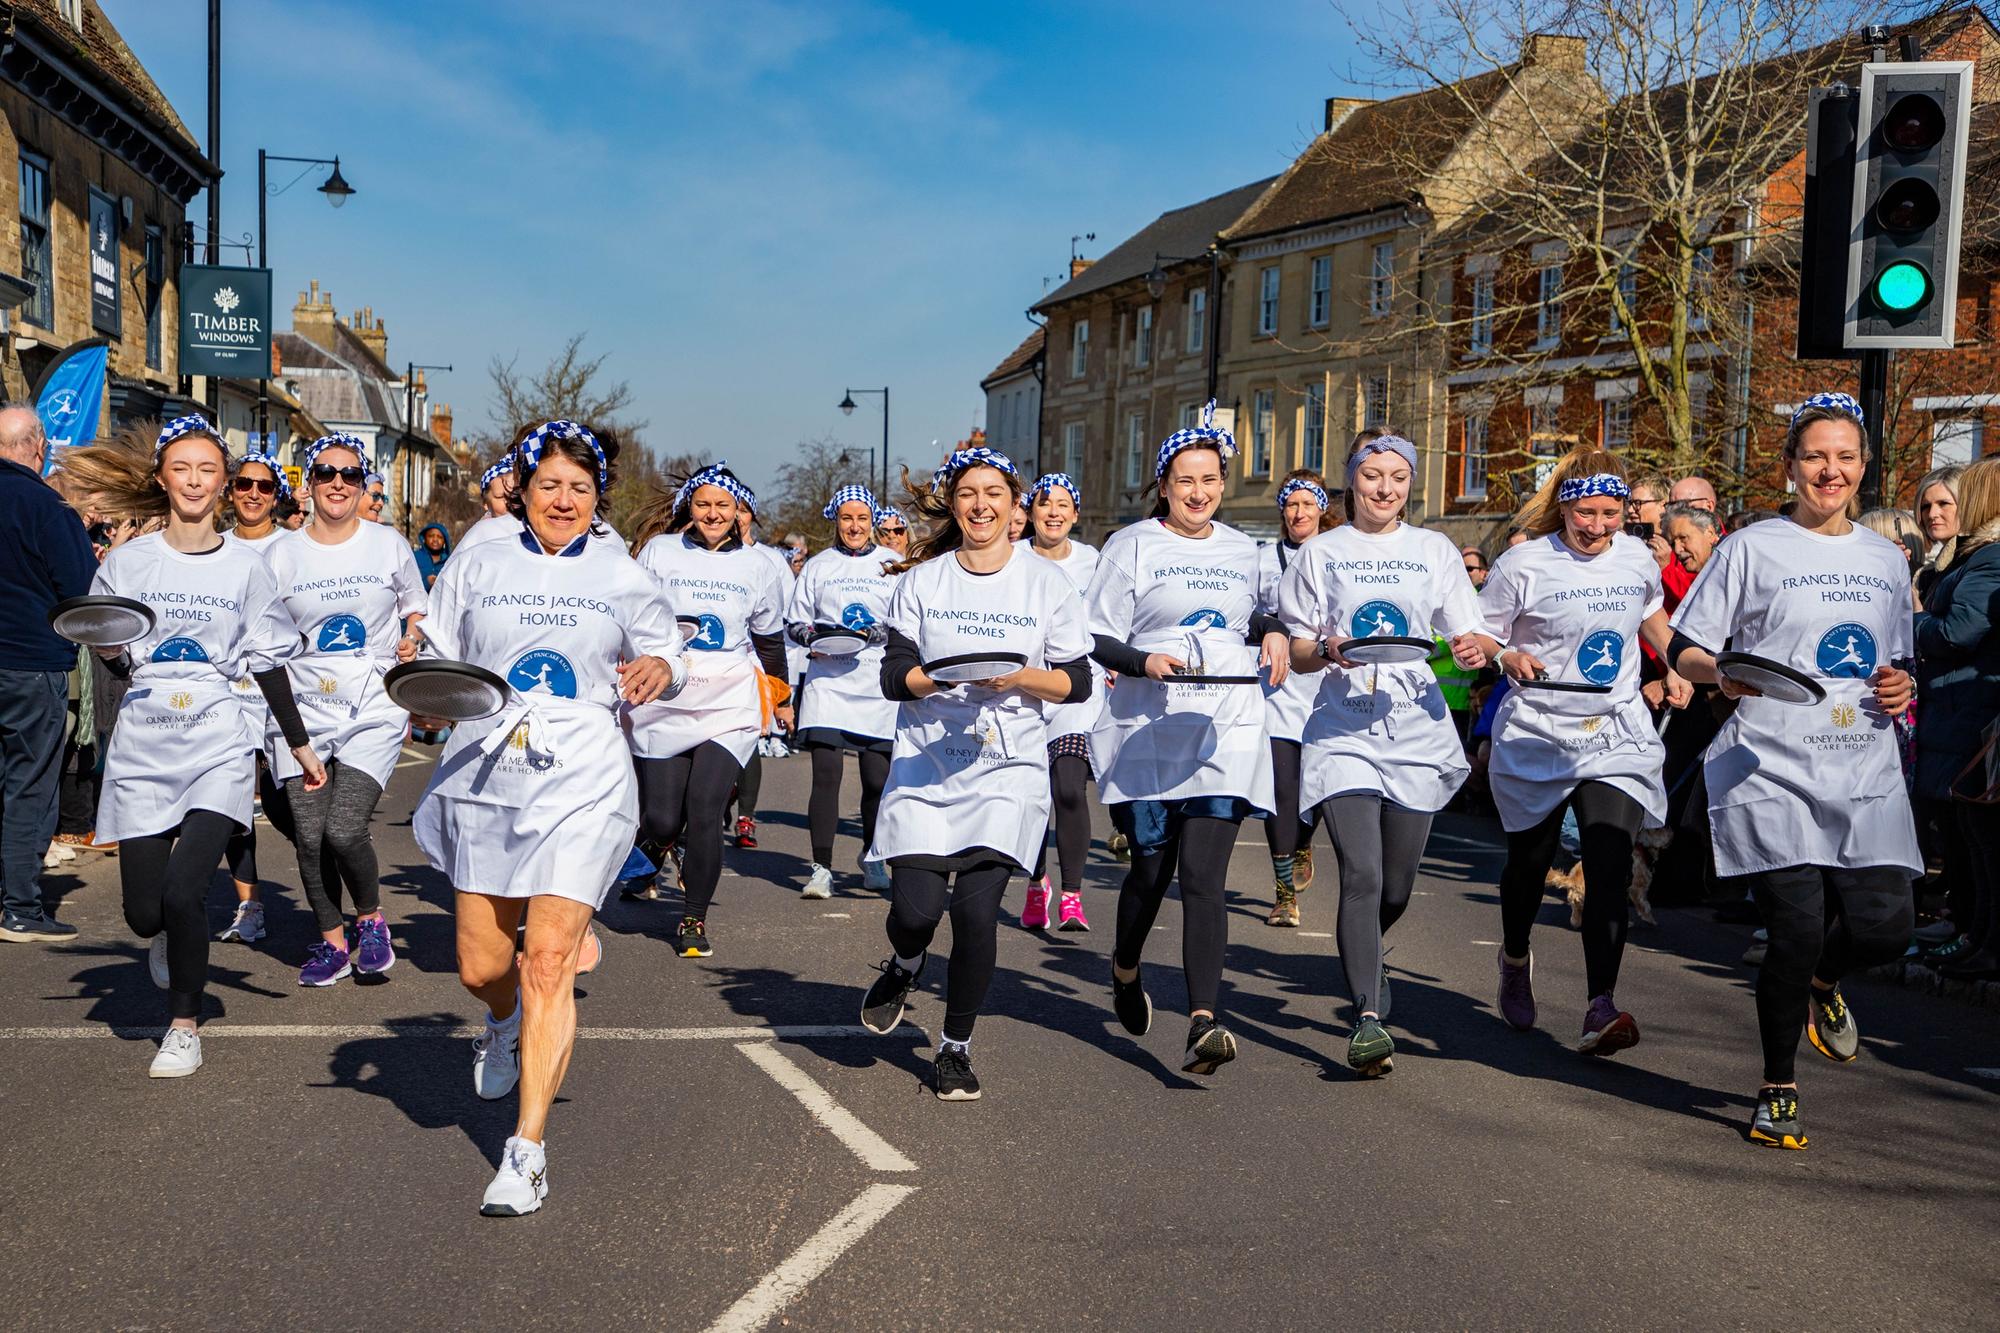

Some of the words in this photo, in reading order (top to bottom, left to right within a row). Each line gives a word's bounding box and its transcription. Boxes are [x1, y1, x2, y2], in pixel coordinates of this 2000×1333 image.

[190, 312, 261, 332] TIMBER
[199, 331, 254, 344] WINDOWS
[1325, 560, 1373, 573] FRANCIS
[1377, 560, 1428, 574] JACKSON
[1154, 566, 1203, 580] FRANCIS
[1205, 568, 1248, 584] JACKSON
[1354, 574, 1400, 584] HOMES
[293, 579, 336, 593] FRANCIS
[339, 575, 384, 587] JACKSON
[670, 578, 708, 588] FRANCIS
[710, 580, 748, 596] JACKSON
[841, 585, 870, 593] HOMES
[856, 577, 889, 588] JACKSON
[1187, 580, 1229, 591] HOMES
[1782, 574, 1840, 590] FRANCIS
[1844, 574, 1893, 594] JACKSON
[320, 588, 361, 601] HOMES
[692, 591, 726, 602] HOMES
[1555, 587, 1603, 602] FRANCIS
[1605, 586, 1646, 598] JACKSON
[1821, 591, 1872, 602] HOMES
[140, 591, 186, 603] RANCIS
[190, 594, 240, 613] JACKSON
[481, 594, 546, 608] FRANCIS
[550, 596, 616, 618] JACKSON
[1587, 601, 1627, 613] HOMES
[165, 608, 212, 622] HOMES
[520, 612, 578, 627] HOMES
[926, 608, 979, 621] FRANCIS
[983, 613, 1038, 627] JACKSON
[957, 625, 1006, 638] HOMES
[1824, 628, 1839, 643] OLNEY
[1839, 625, 1862, 633] PANCAKE
[1861, 629, 1872, 643] RACE
[160, 640, 175, 651] OLNEY
[516, 654, 533, 669] OLNEY
[534, 652, 560, 662] PANCAKE
[559, 658, 570, 672] RACE
[146, 715, 173, 725] OLNEY
[175, 710, 219, 722] MEADOWS
[183, 720, 208, 729] HOME
[1803, 734, 1833, 744] OLNEY
[946, 747, 972, 757] OLNEY
[1817, 743, 1840, 751] CARE
[480, 752, 506, 764] OLNEY
[508, 756, 563, 769] MEADOWS
[494, 764, 513, 773] ARE
[518, 767, 547, 776] HOME
